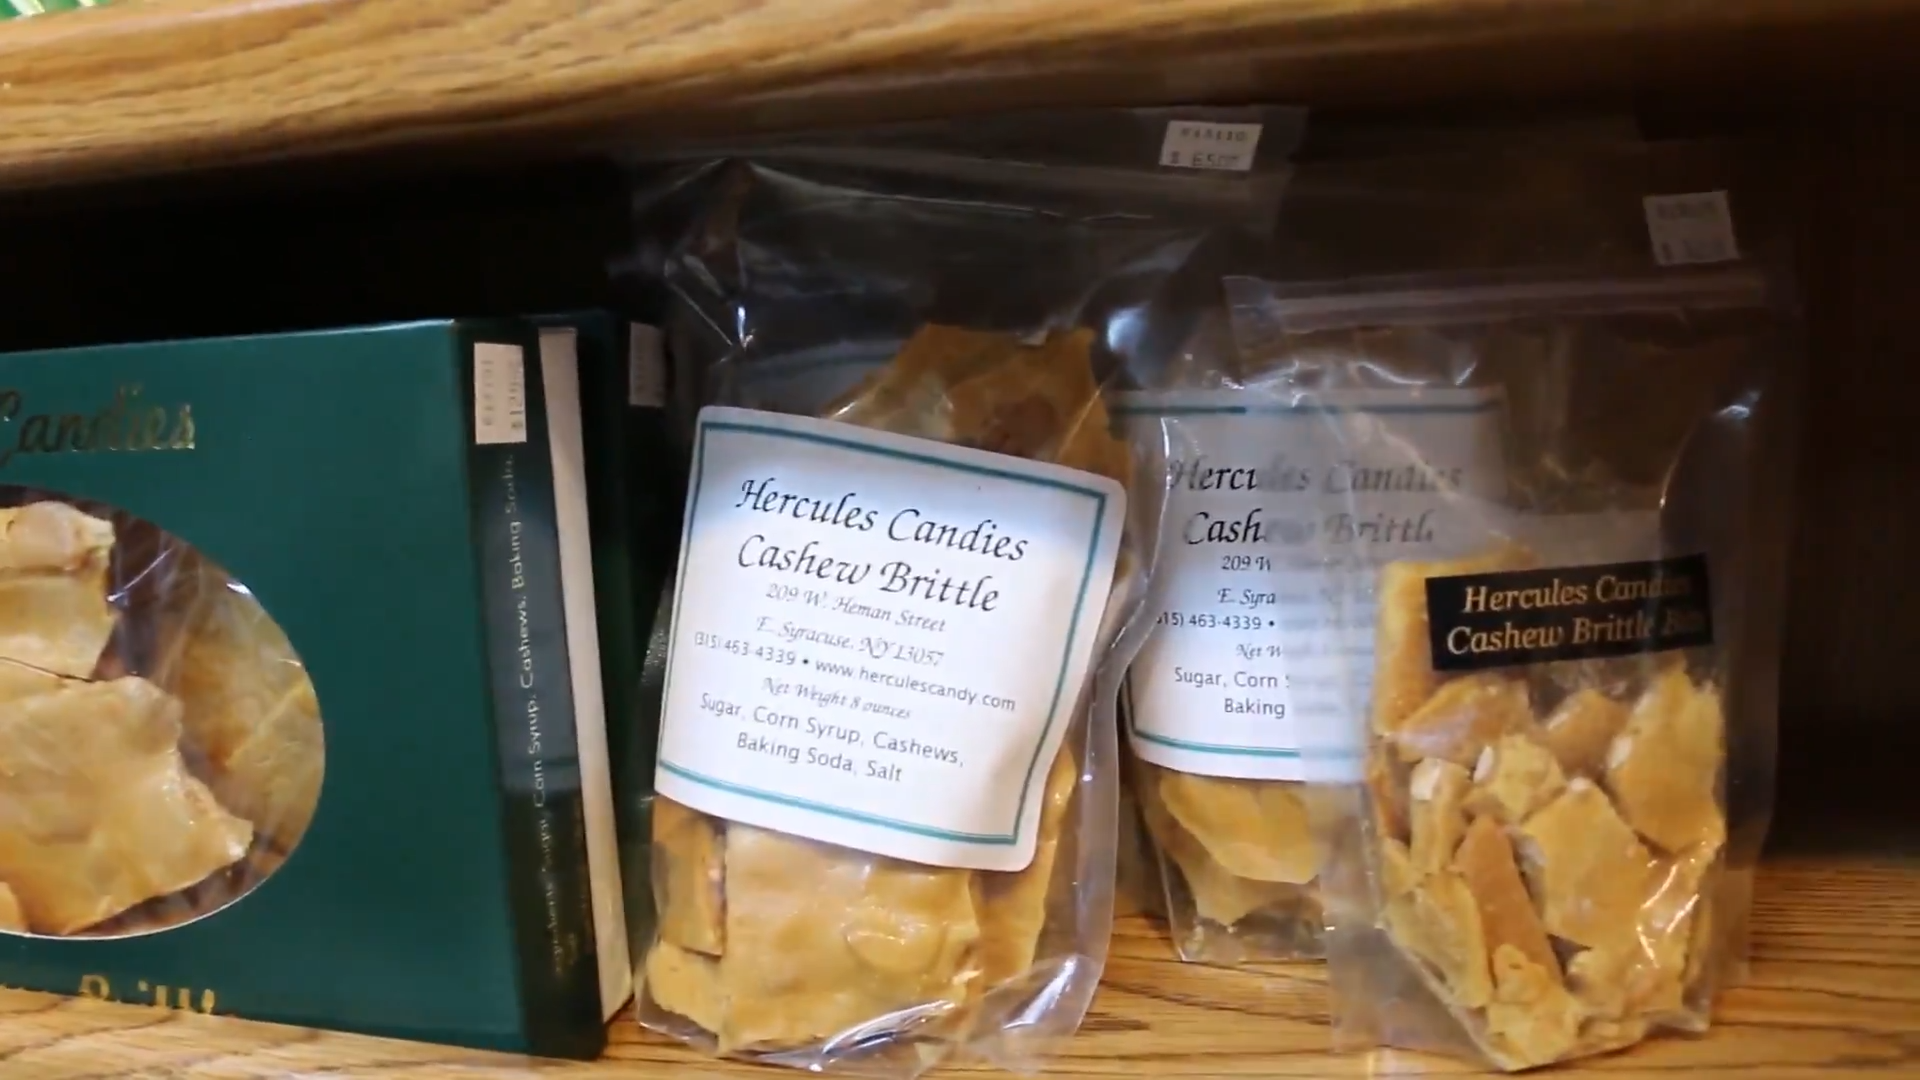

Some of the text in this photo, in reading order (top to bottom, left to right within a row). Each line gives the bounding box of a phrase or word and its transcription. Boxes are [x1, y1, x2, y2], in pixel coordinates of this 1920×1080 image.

[735, 478, 1029, 562] Hercules Candies
[1183, 508, 1317, 546] Cash
[509, 521, 525, 589] Baking
[738, 534, 999, 612] Cashew Brittle
[1221, 555, 1252, 572] 209
[766, 583, 799, 602] 209
[832, 597, 892, 623] Heman
[895, 608, 947, 633] Street
[1463, 578, 1588, 614] Hercules
[517, 596, 534, 687] Cashews,
[1189, 613, 1263, 631] 463-4339
[1447, 621, 1566, 656] Cashew
[857, 636, 897, 660] NY
[894, 645, 945, 668] 13057
[1236, 643, 1263, 661] Net
[762, 675, 914, 721] Net Weight 8 ounces
[816, 660, 1017, 713] www.herculescandy.com
[1174, 666, 1228, 689] Sugar,
[1234, 671, 1279, 689] Corn
[700, 692, 966, 768] Sugar, Corn Syrup, Cashews,
[1224, 698, 1286, 720] Baking
[736, 731, 903, 783] Baking Soda, Salt
